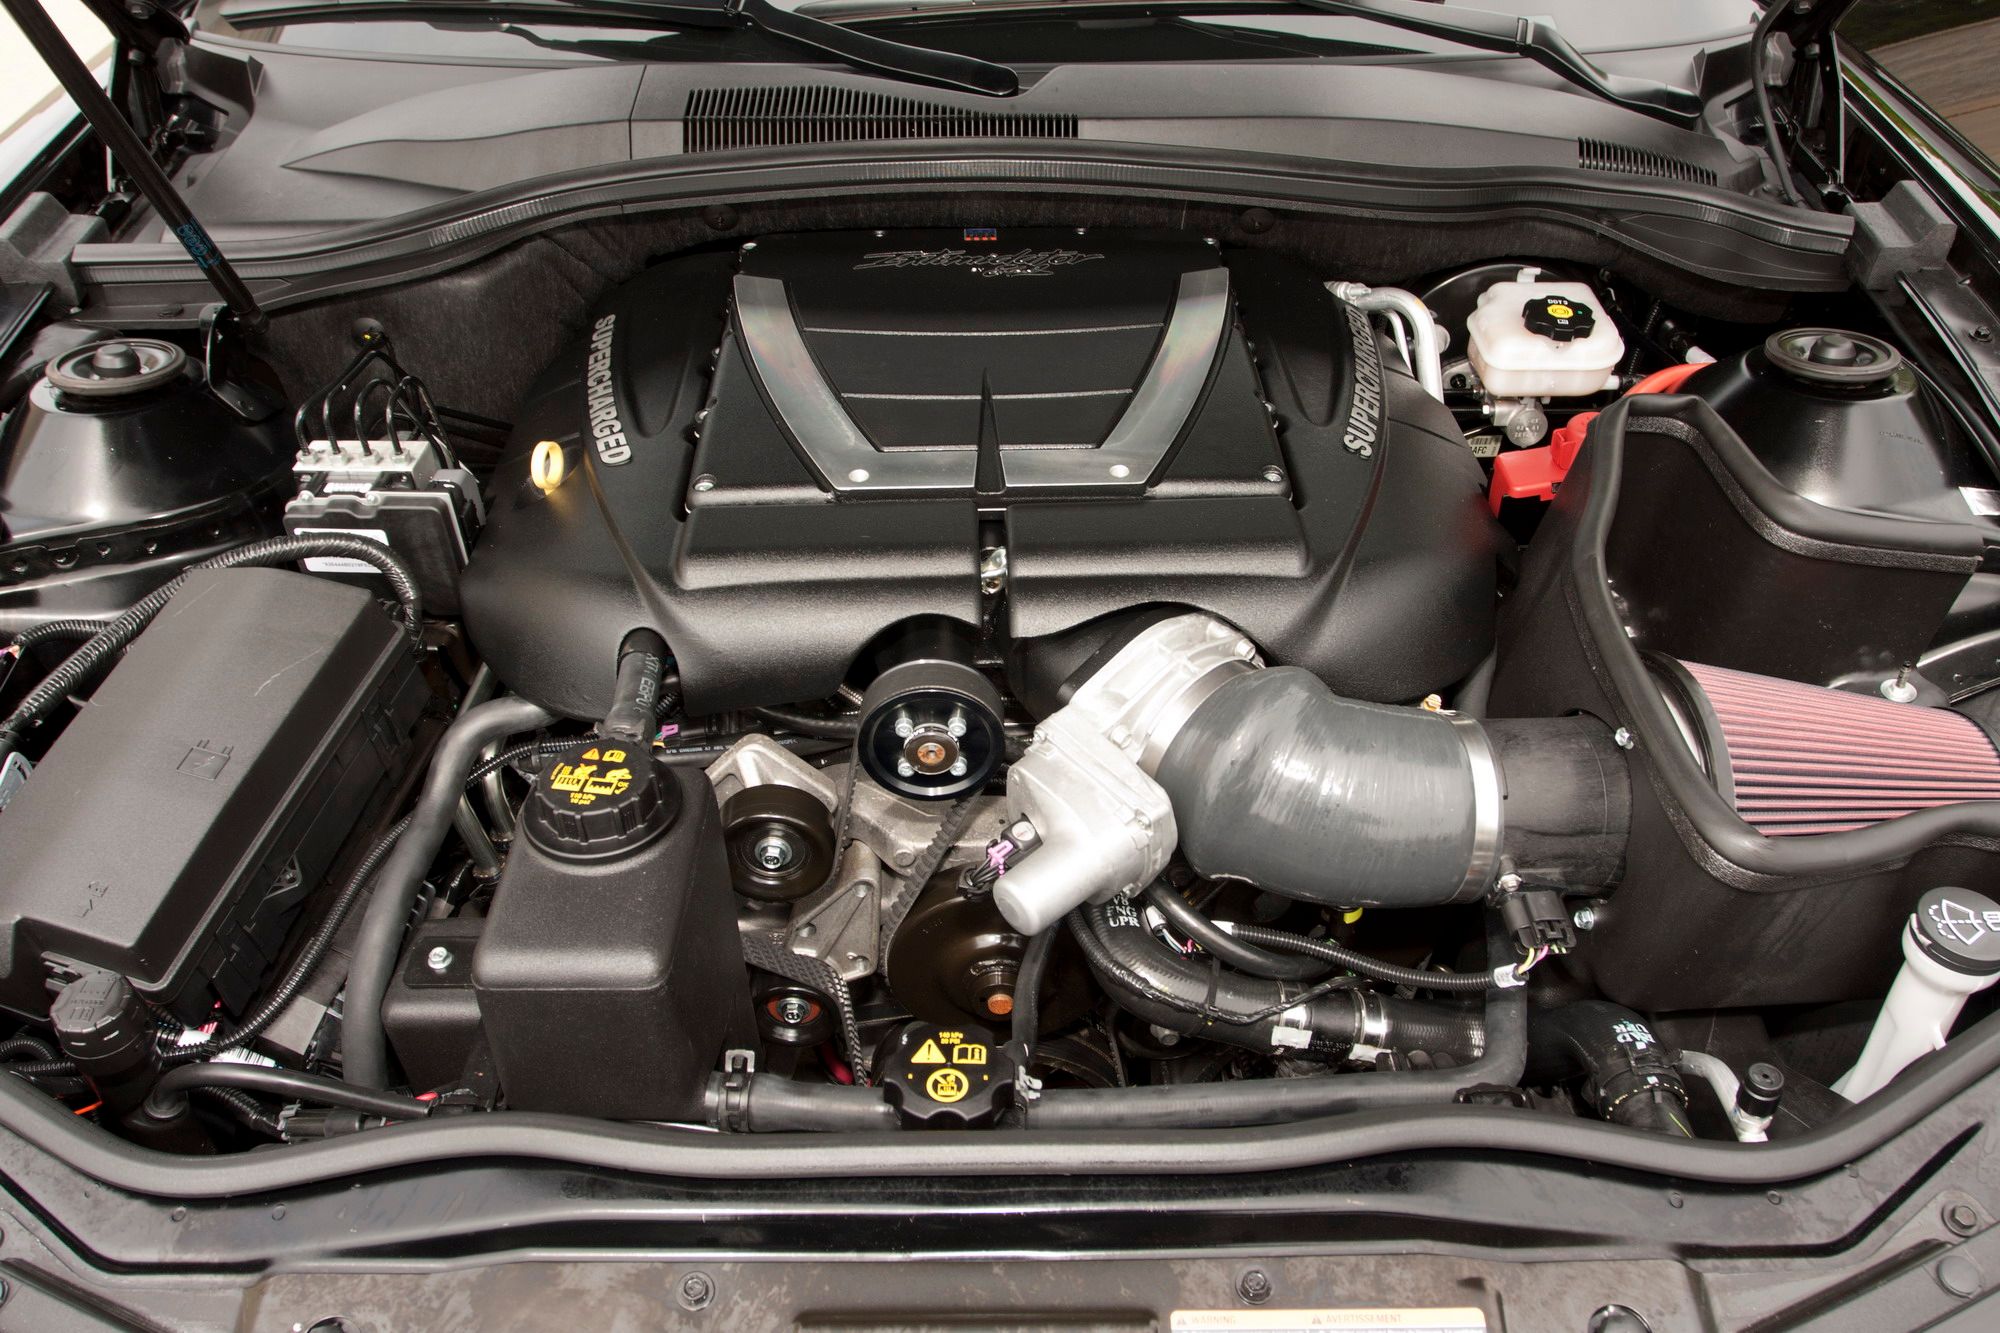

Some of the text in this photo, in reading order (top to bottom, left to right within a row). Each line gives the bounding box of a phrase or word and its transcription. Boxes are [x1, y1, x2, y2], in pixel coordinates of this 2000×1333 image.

[1343, 304, 1381, 459] SUPERCHARGED
[587, 313, 632, 466] SUPERCHARGED
[1109, 915, 1141, 928] UPR
[1192, 1316, 1236, 1325] WARNING
[1326, 1314, 1402, 1324] AVERTISSEMENT
